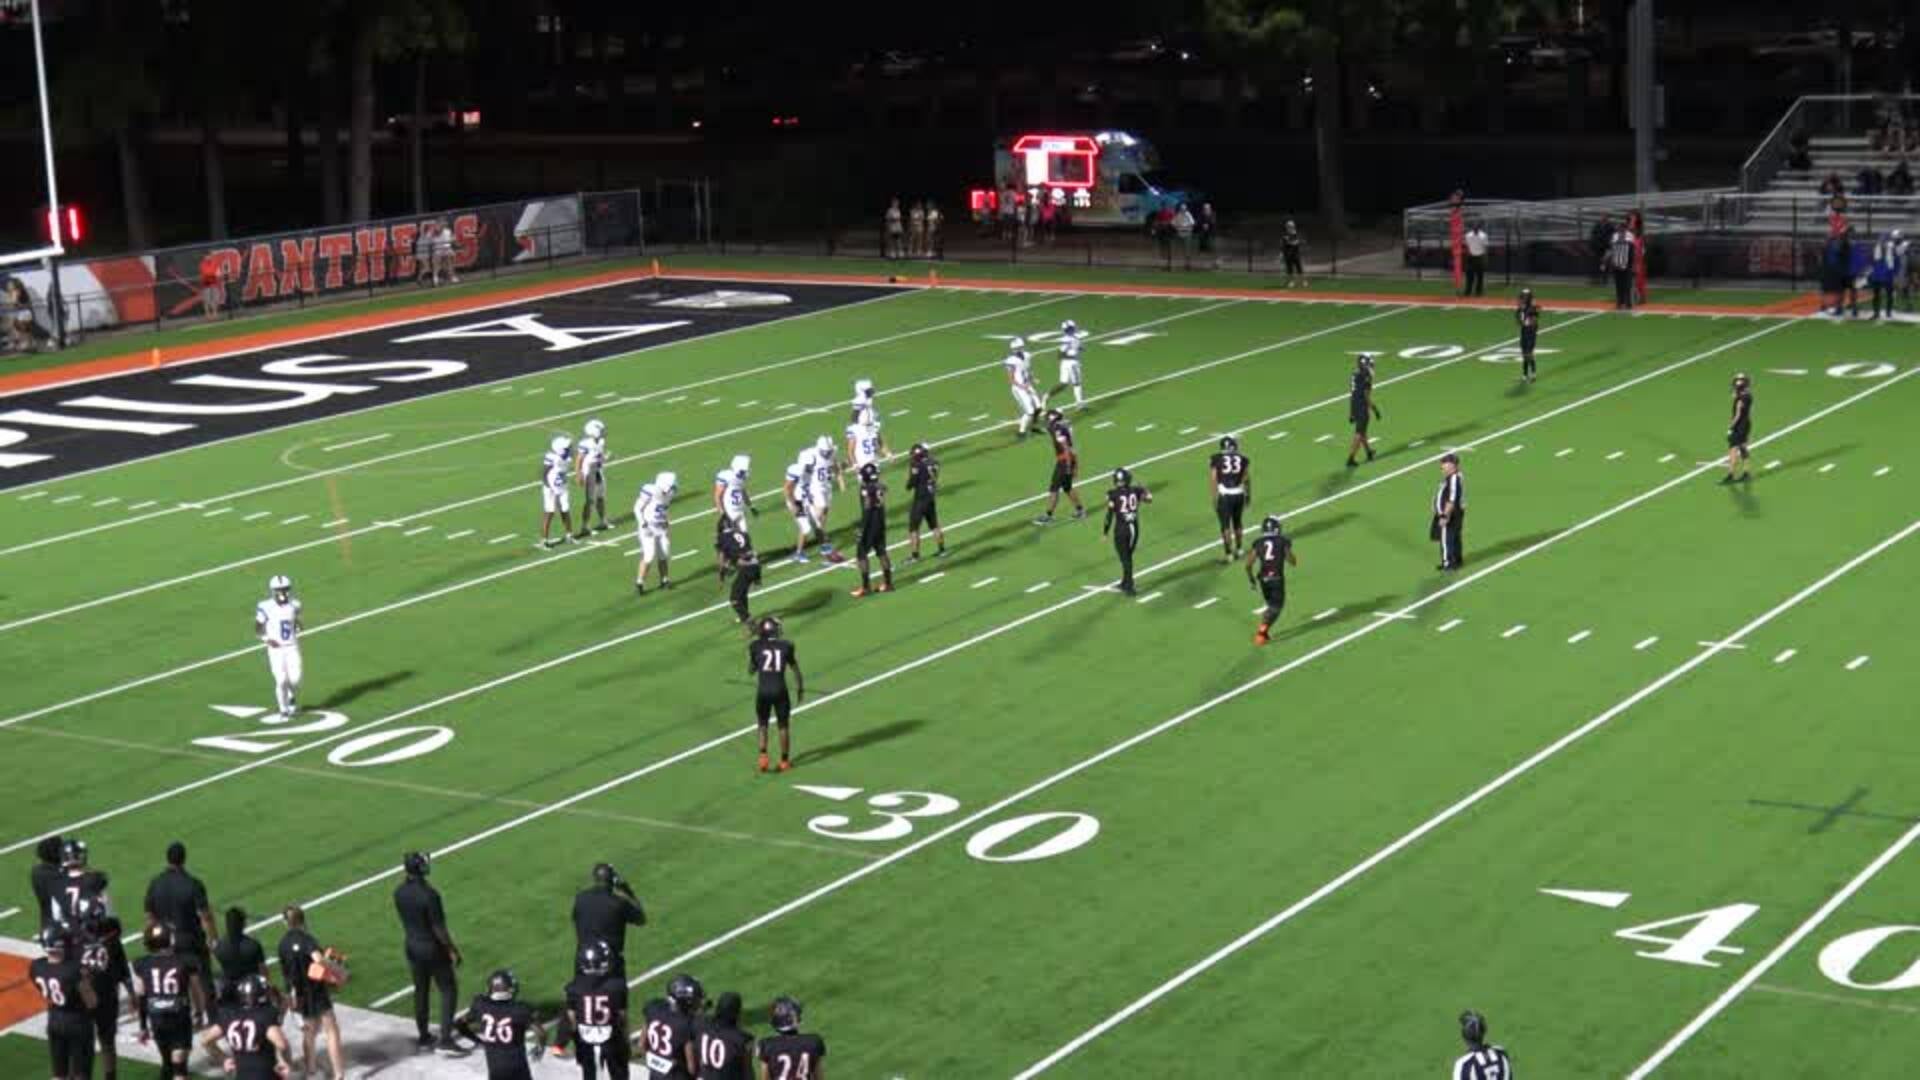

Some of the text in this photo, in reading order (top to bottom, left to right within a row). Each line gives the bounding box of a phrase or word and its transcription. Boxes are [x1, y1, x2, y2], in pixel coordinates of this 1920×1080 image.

[391, 313, 692, 352] X
[1221, 455, 1242, 474] 33
[1119, 494, 1137, 513] 20
[1264, 541, 1275, 561] 2
[279, 619, 292, 641] 6
[762, 649, 782, 673] 21
[191, 710, 455, 767] 20
[807, 791, 1101, 863] 30
[65, 886, 80, 916] 7
[1613, 902, 1920, 991] 40
[151, 967, 179, 995] 16
[583, 995, 611, 1025] 15
[226, 1019, 258, 1051] 62
[478, 1013, 513, 1043] 26
[647, 1020, 674, 1057] 63
[701, 1033, 726, 1069] 10
[777, 1052, 810, 1080] 24
